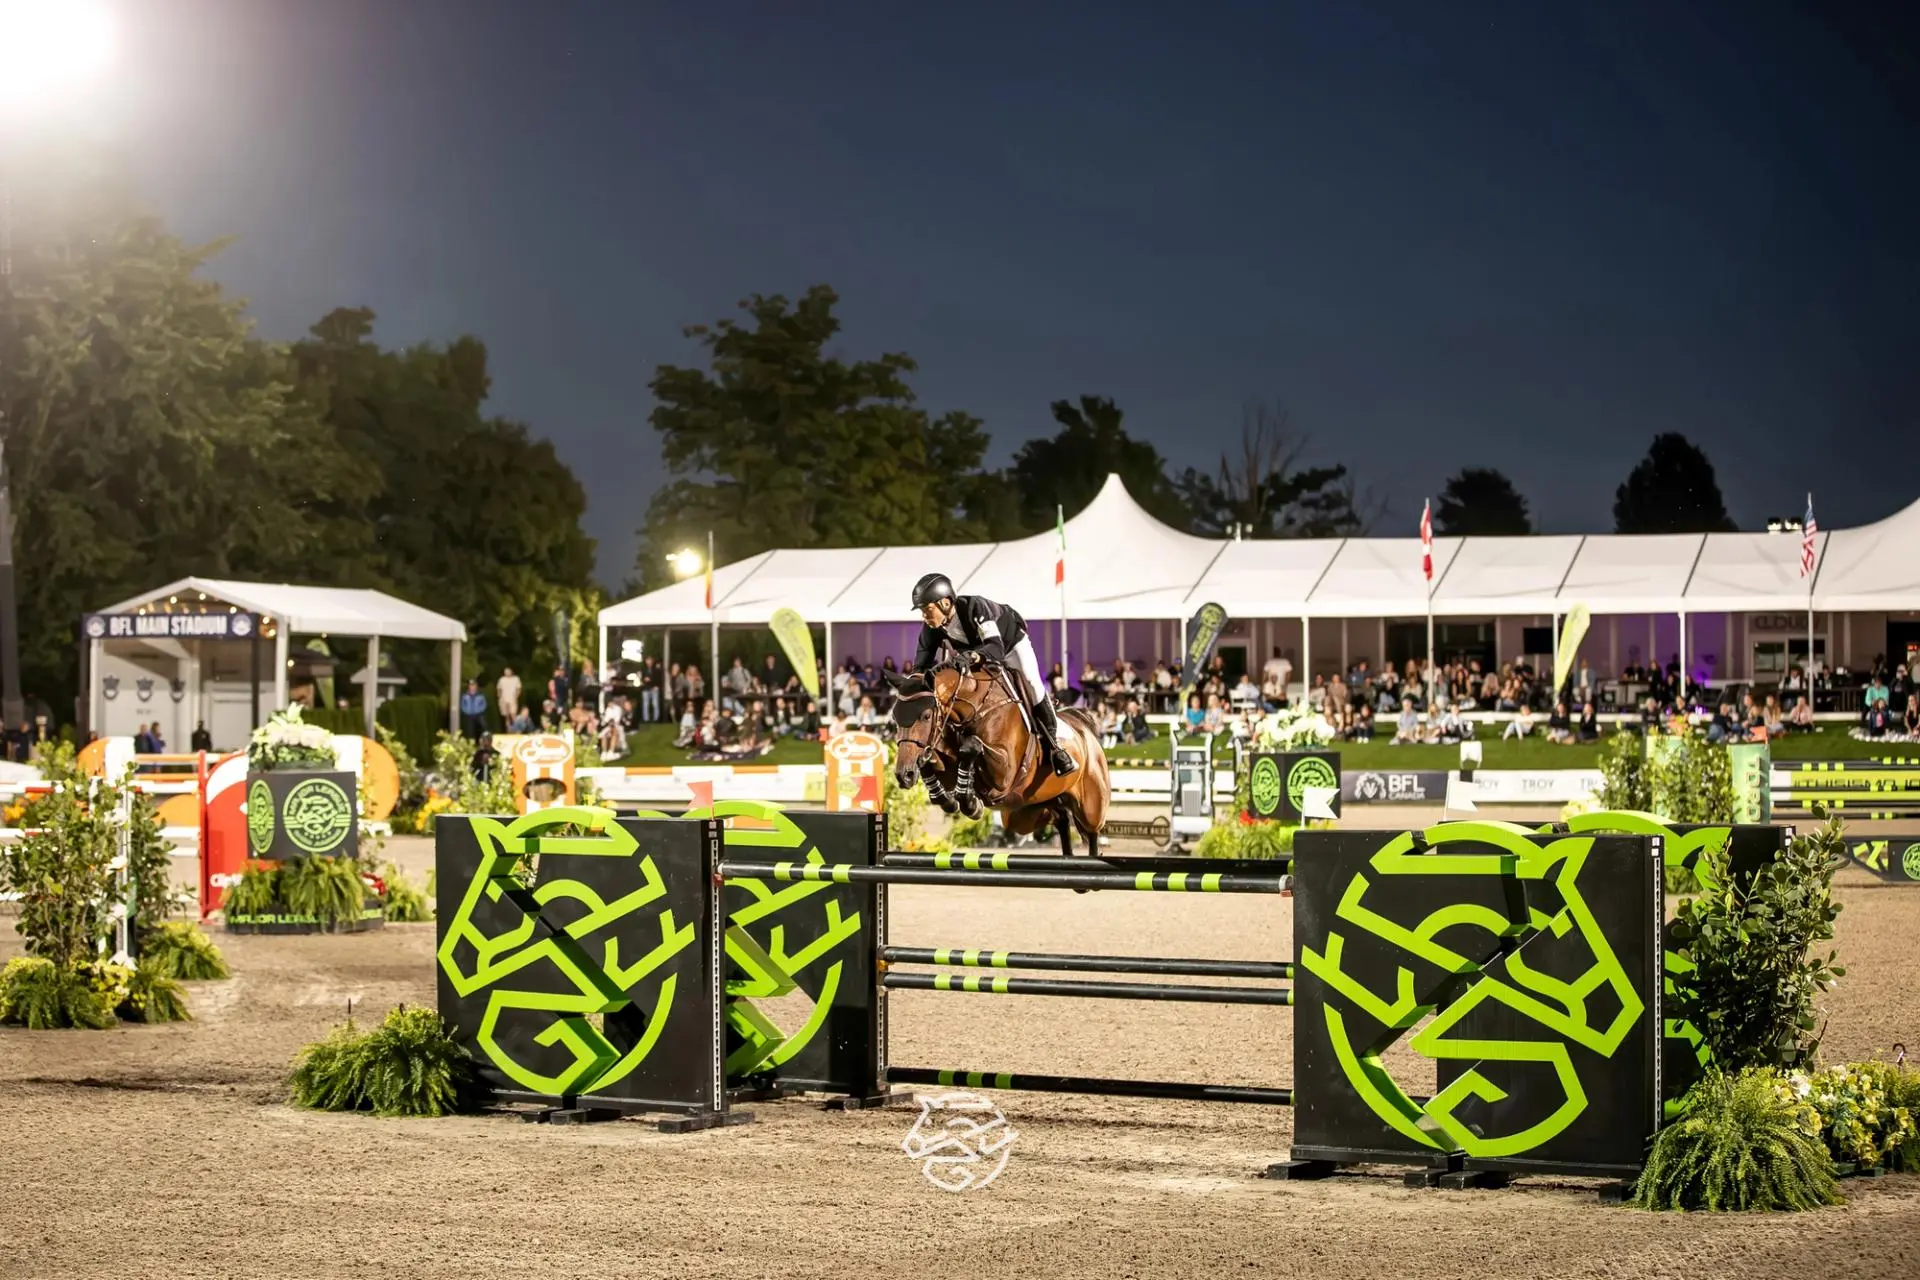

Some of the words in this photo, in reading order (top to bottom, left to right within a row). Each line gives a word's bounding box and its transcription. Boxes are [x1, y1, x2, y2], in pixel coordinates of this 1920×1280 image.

[109, 615, 134, 636] BFL
[135, 615, 169, 636] MAIN
[171, 615, 228, 636] STADIUM
[1388, 774, 1426, 793] BFL
[1522, 778, 1555, 790] TROY
[1388, 792, 1425, 800] CANADA
